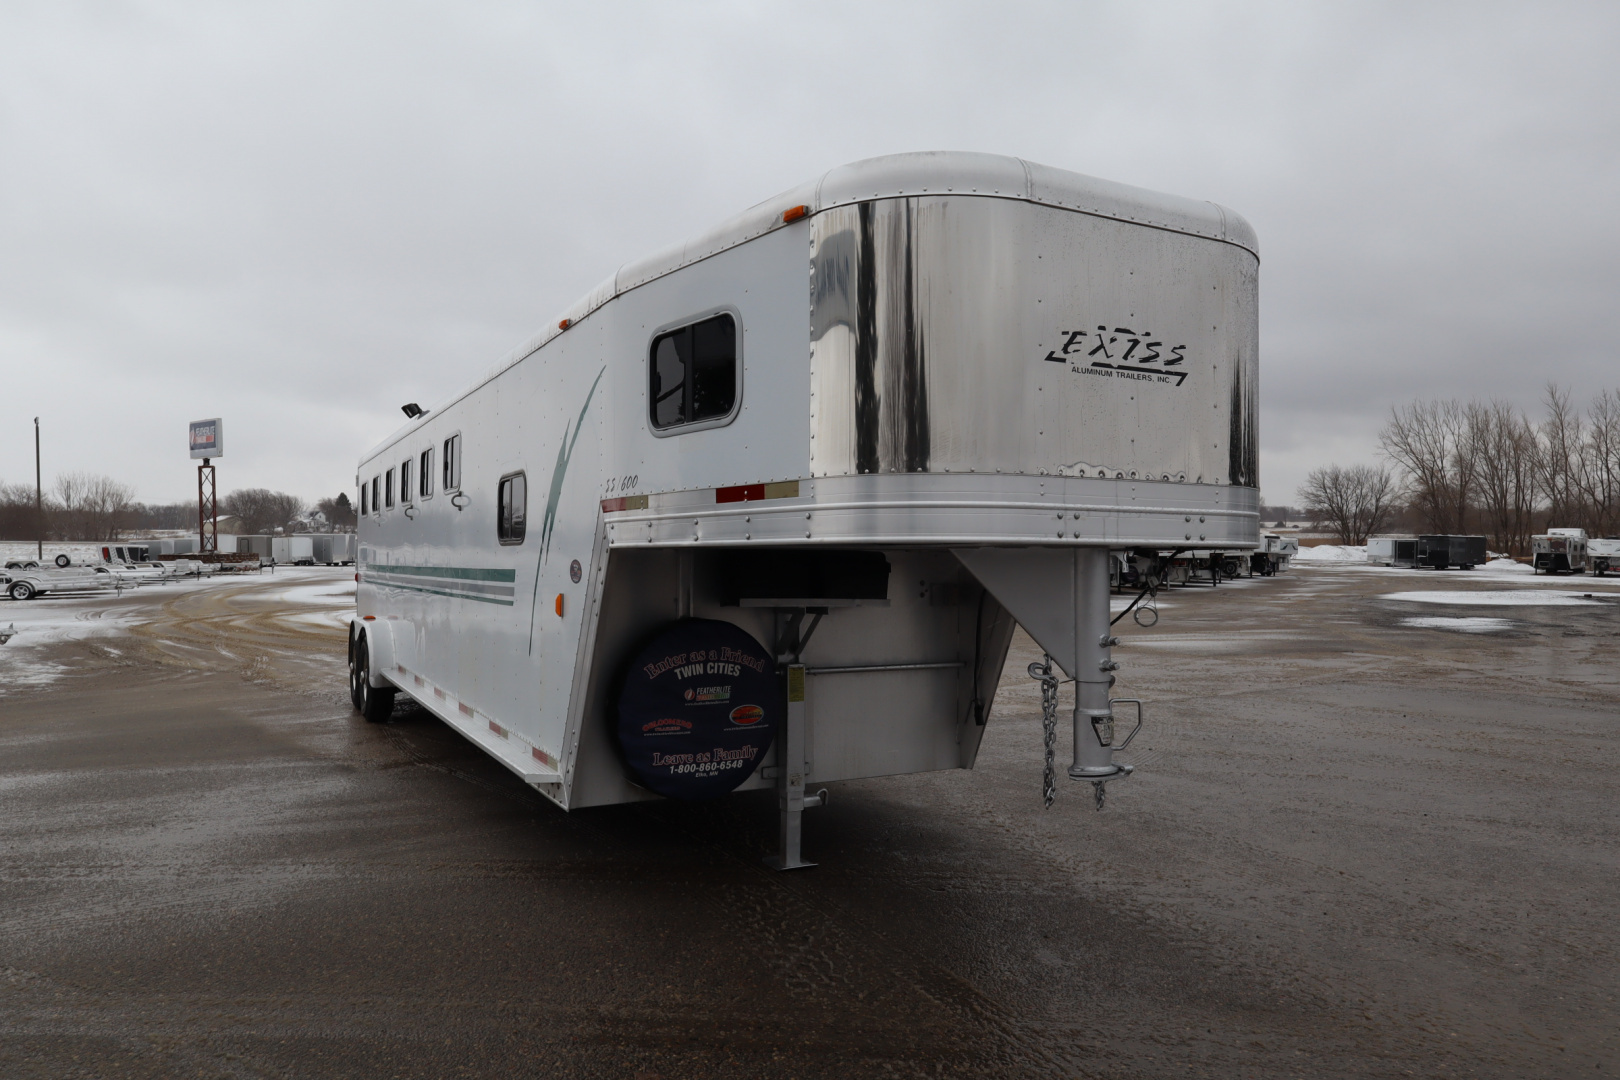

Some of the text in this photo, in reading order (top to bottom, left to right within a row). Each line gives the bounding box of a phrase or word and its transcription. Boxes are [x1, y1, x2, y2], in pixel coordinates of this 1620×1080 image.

[1061, 325, 1186, 366] EXISS
[1071, 366, 1171, 384] ALUMINUM TRAILERS, INC.
[644, 646, 765, 679] Enter as a Friend
[674, 661, 741, 680] TWIN CITIES
[696, 685, 732, 695] FEATHERLITE
[652, 744, 759, 766] Leave as Family
[670, 760, 743, 774] 1-800-860-6548
